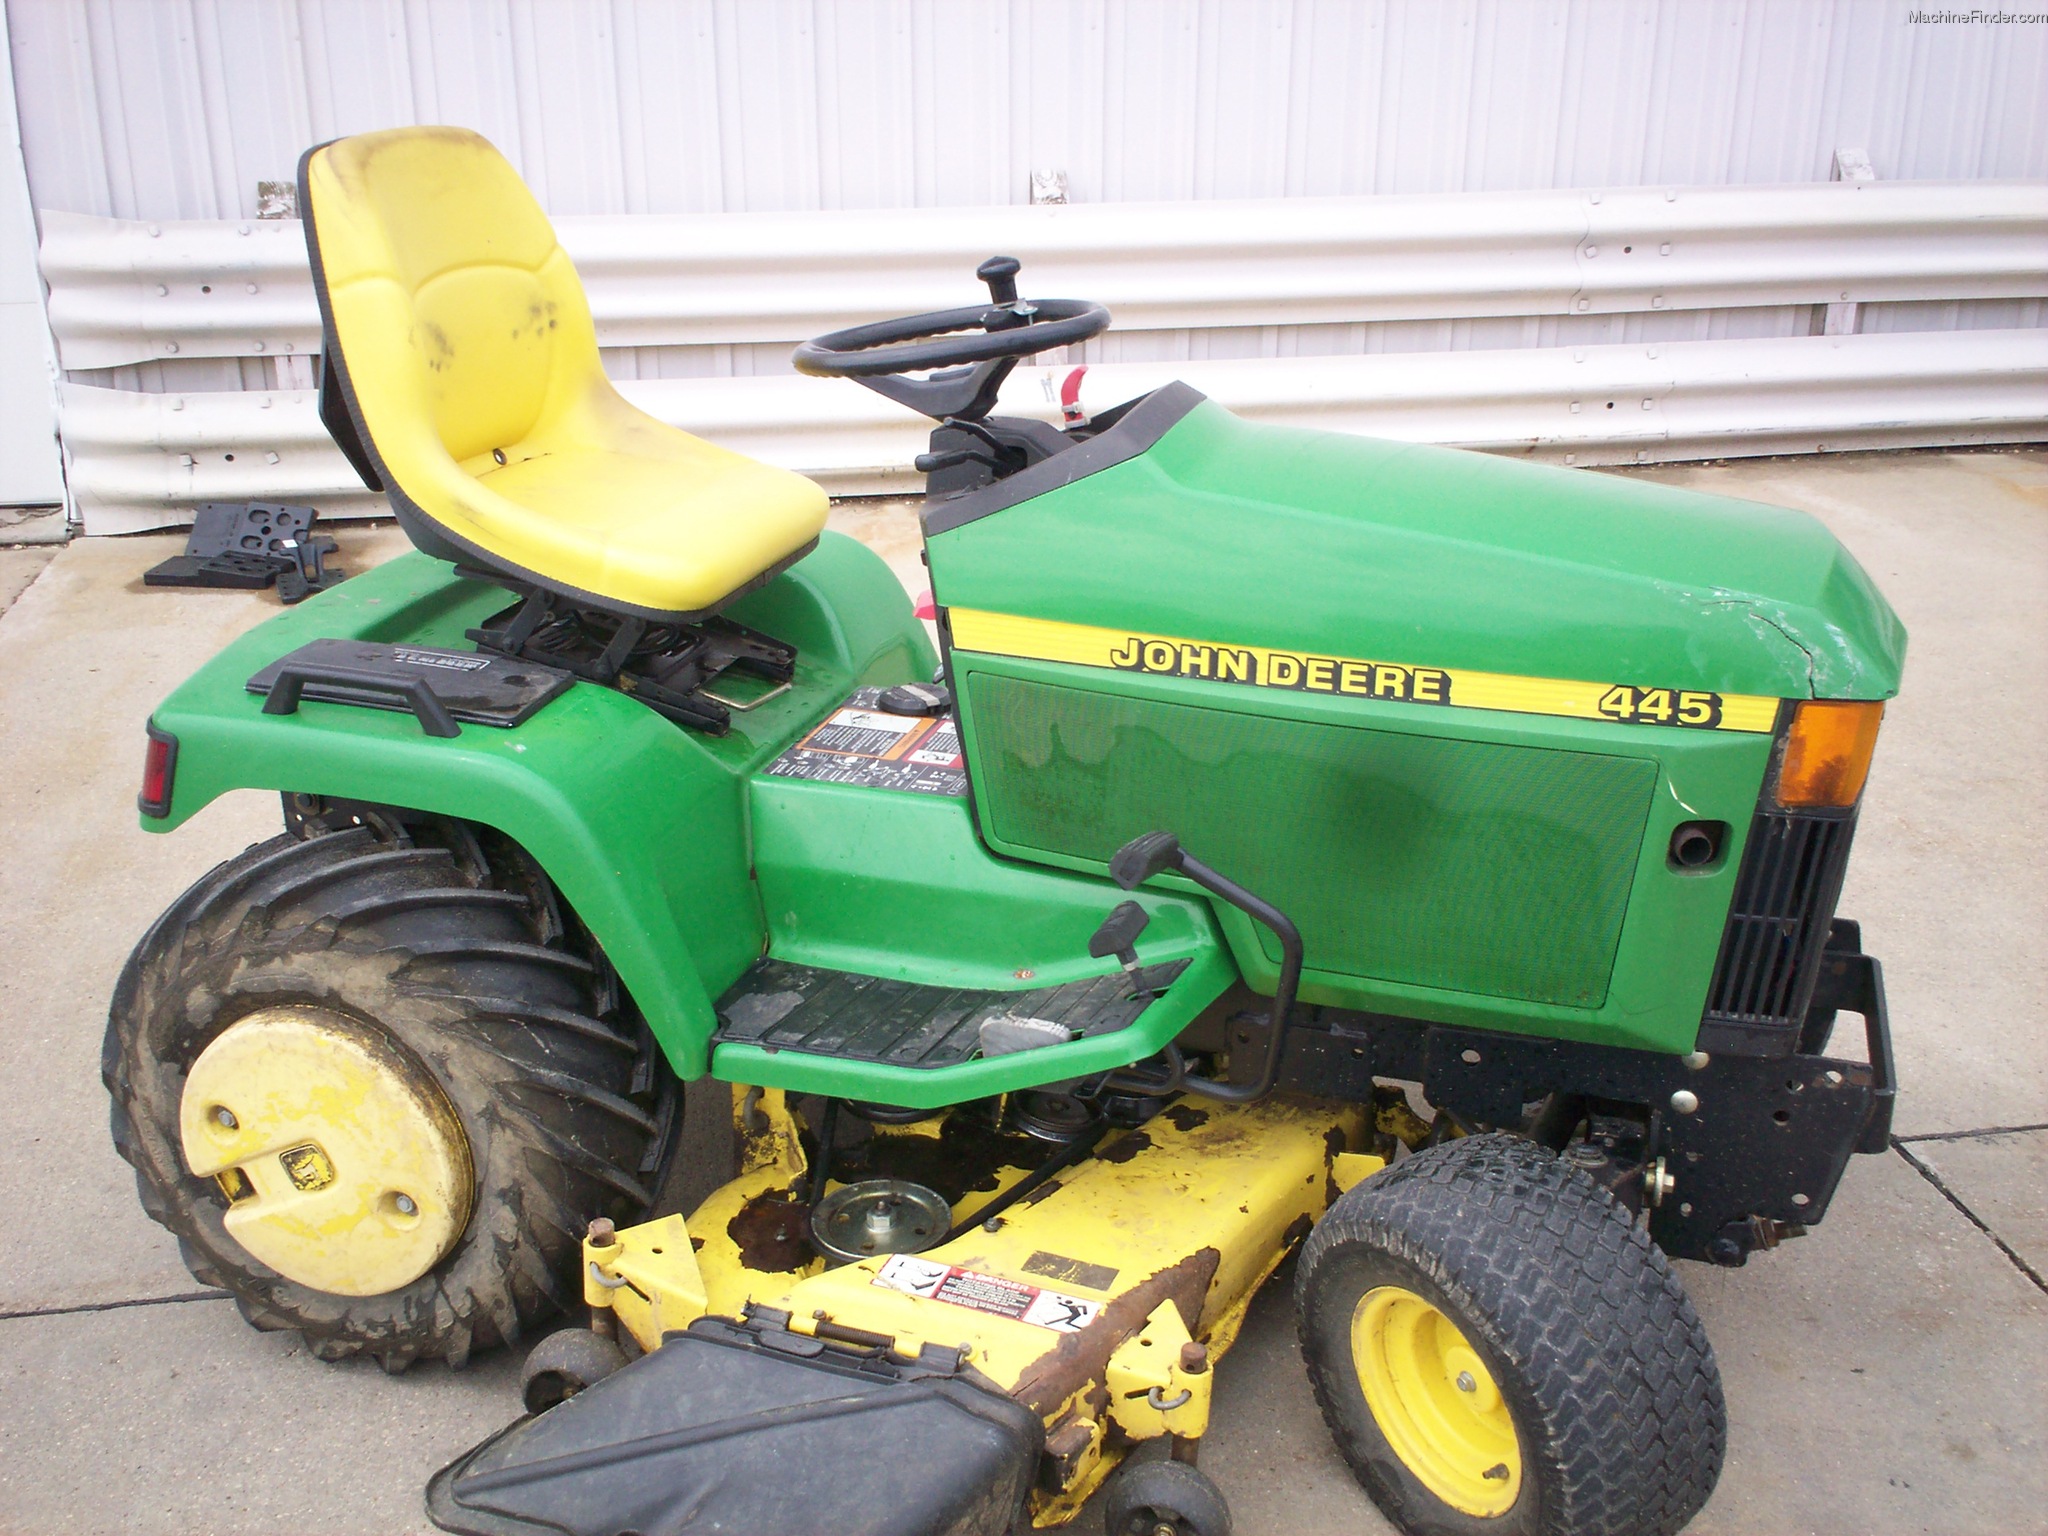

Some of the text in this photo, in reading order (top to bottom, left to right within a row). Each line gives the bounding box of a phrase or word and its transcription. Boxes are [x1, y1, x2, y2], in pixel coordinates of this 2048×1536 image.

[1111, 637, 1451, 705] JOHN DEERE
[1599, 685, 1721, 728] 445
[975, 1273, 1030, 1292] DANGER
